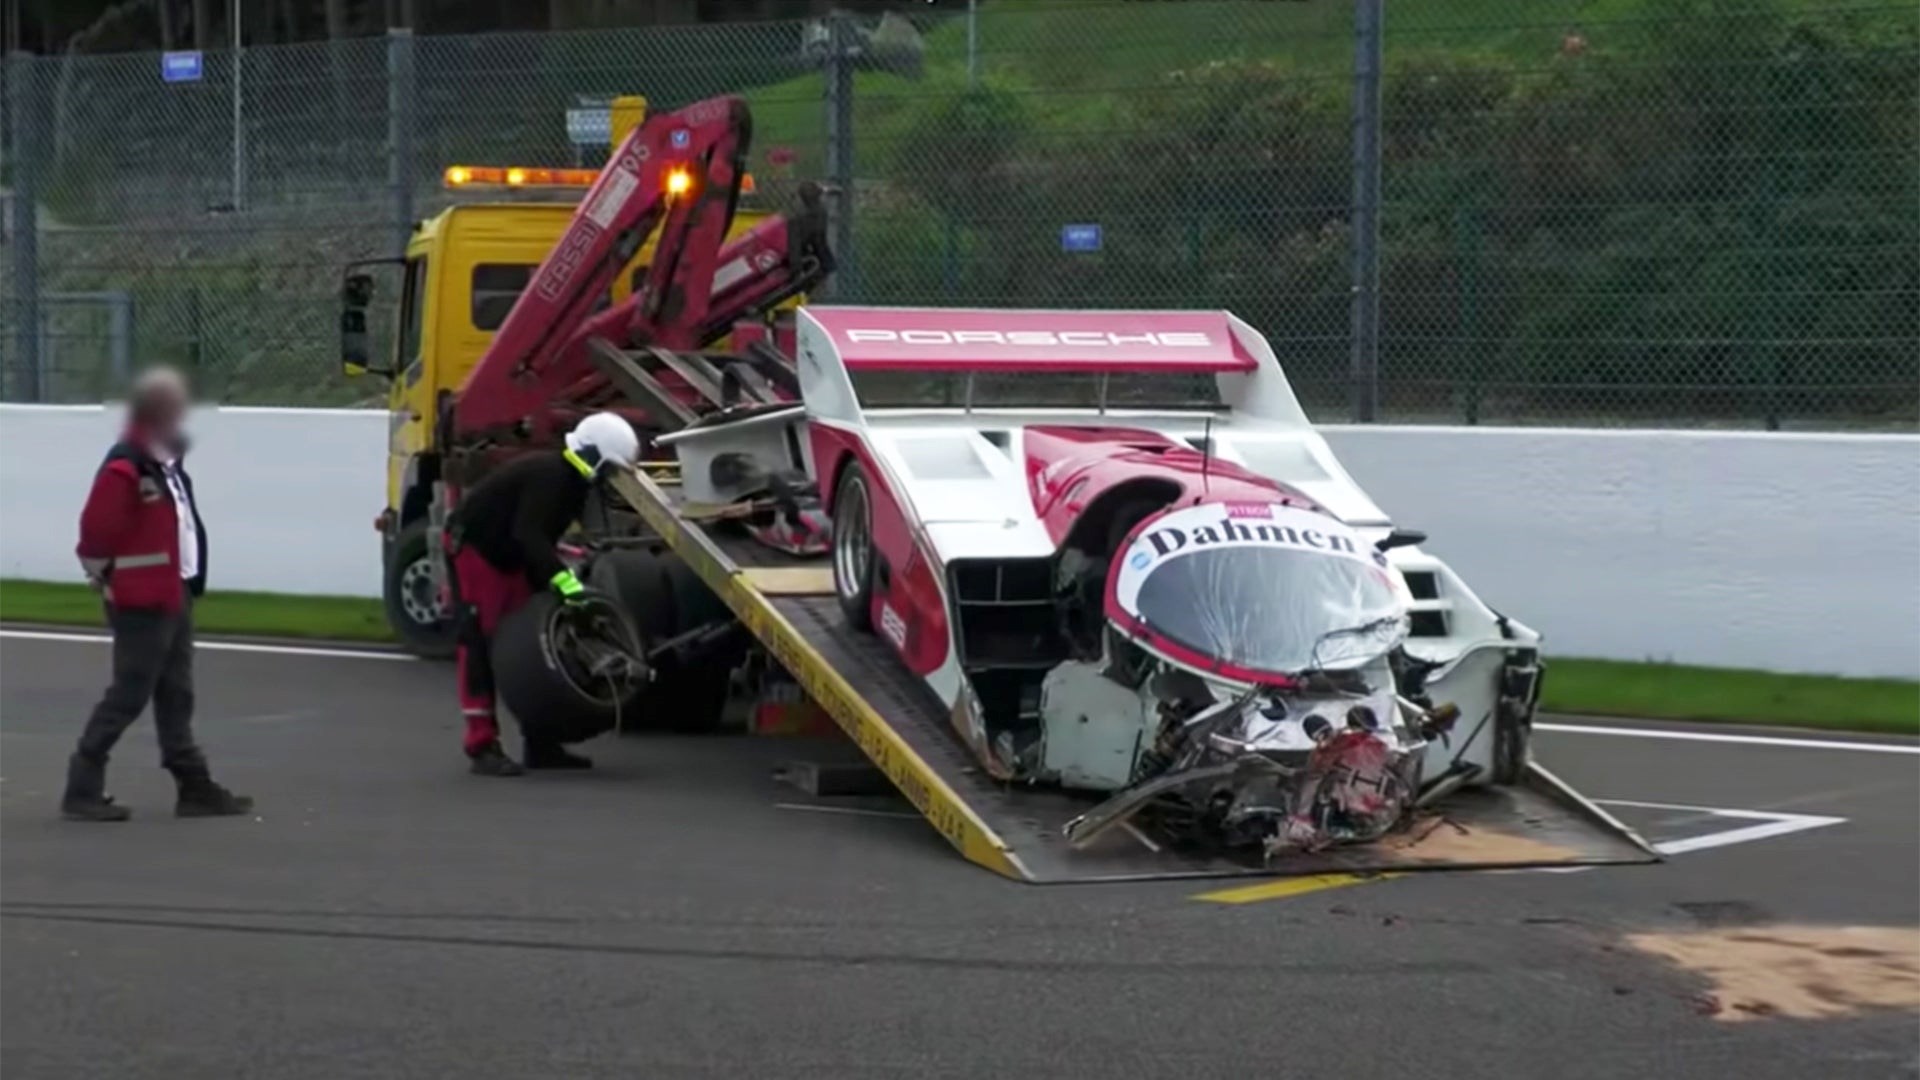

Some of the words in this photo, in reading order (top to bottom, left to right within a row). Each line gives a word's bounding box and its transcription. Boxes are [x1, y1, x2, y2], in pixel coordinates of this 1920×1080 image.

[541, 220, 599, 298] FASSI
[845, 328, 1211, 347] PORSCHE
[1147, 518, 1357, 555] Dahmen
